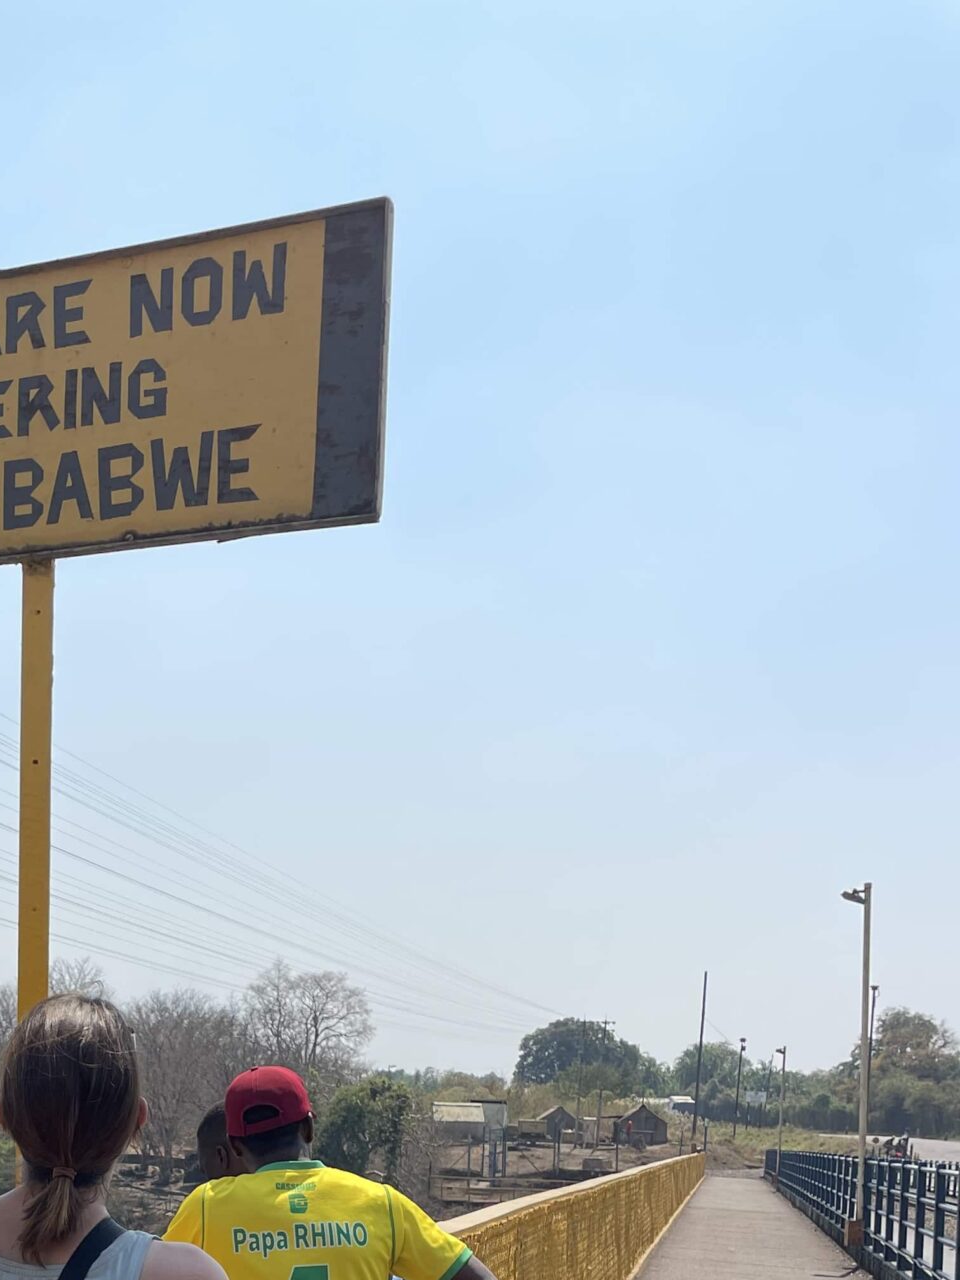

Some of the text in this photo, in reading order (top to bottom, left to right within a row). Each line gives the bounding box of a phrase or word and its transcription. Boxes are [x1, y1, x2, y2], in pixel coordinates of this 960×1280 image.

[129, 241, 288, 338] NOW
[232, 1221, 368, 1258] Papa RHINO
